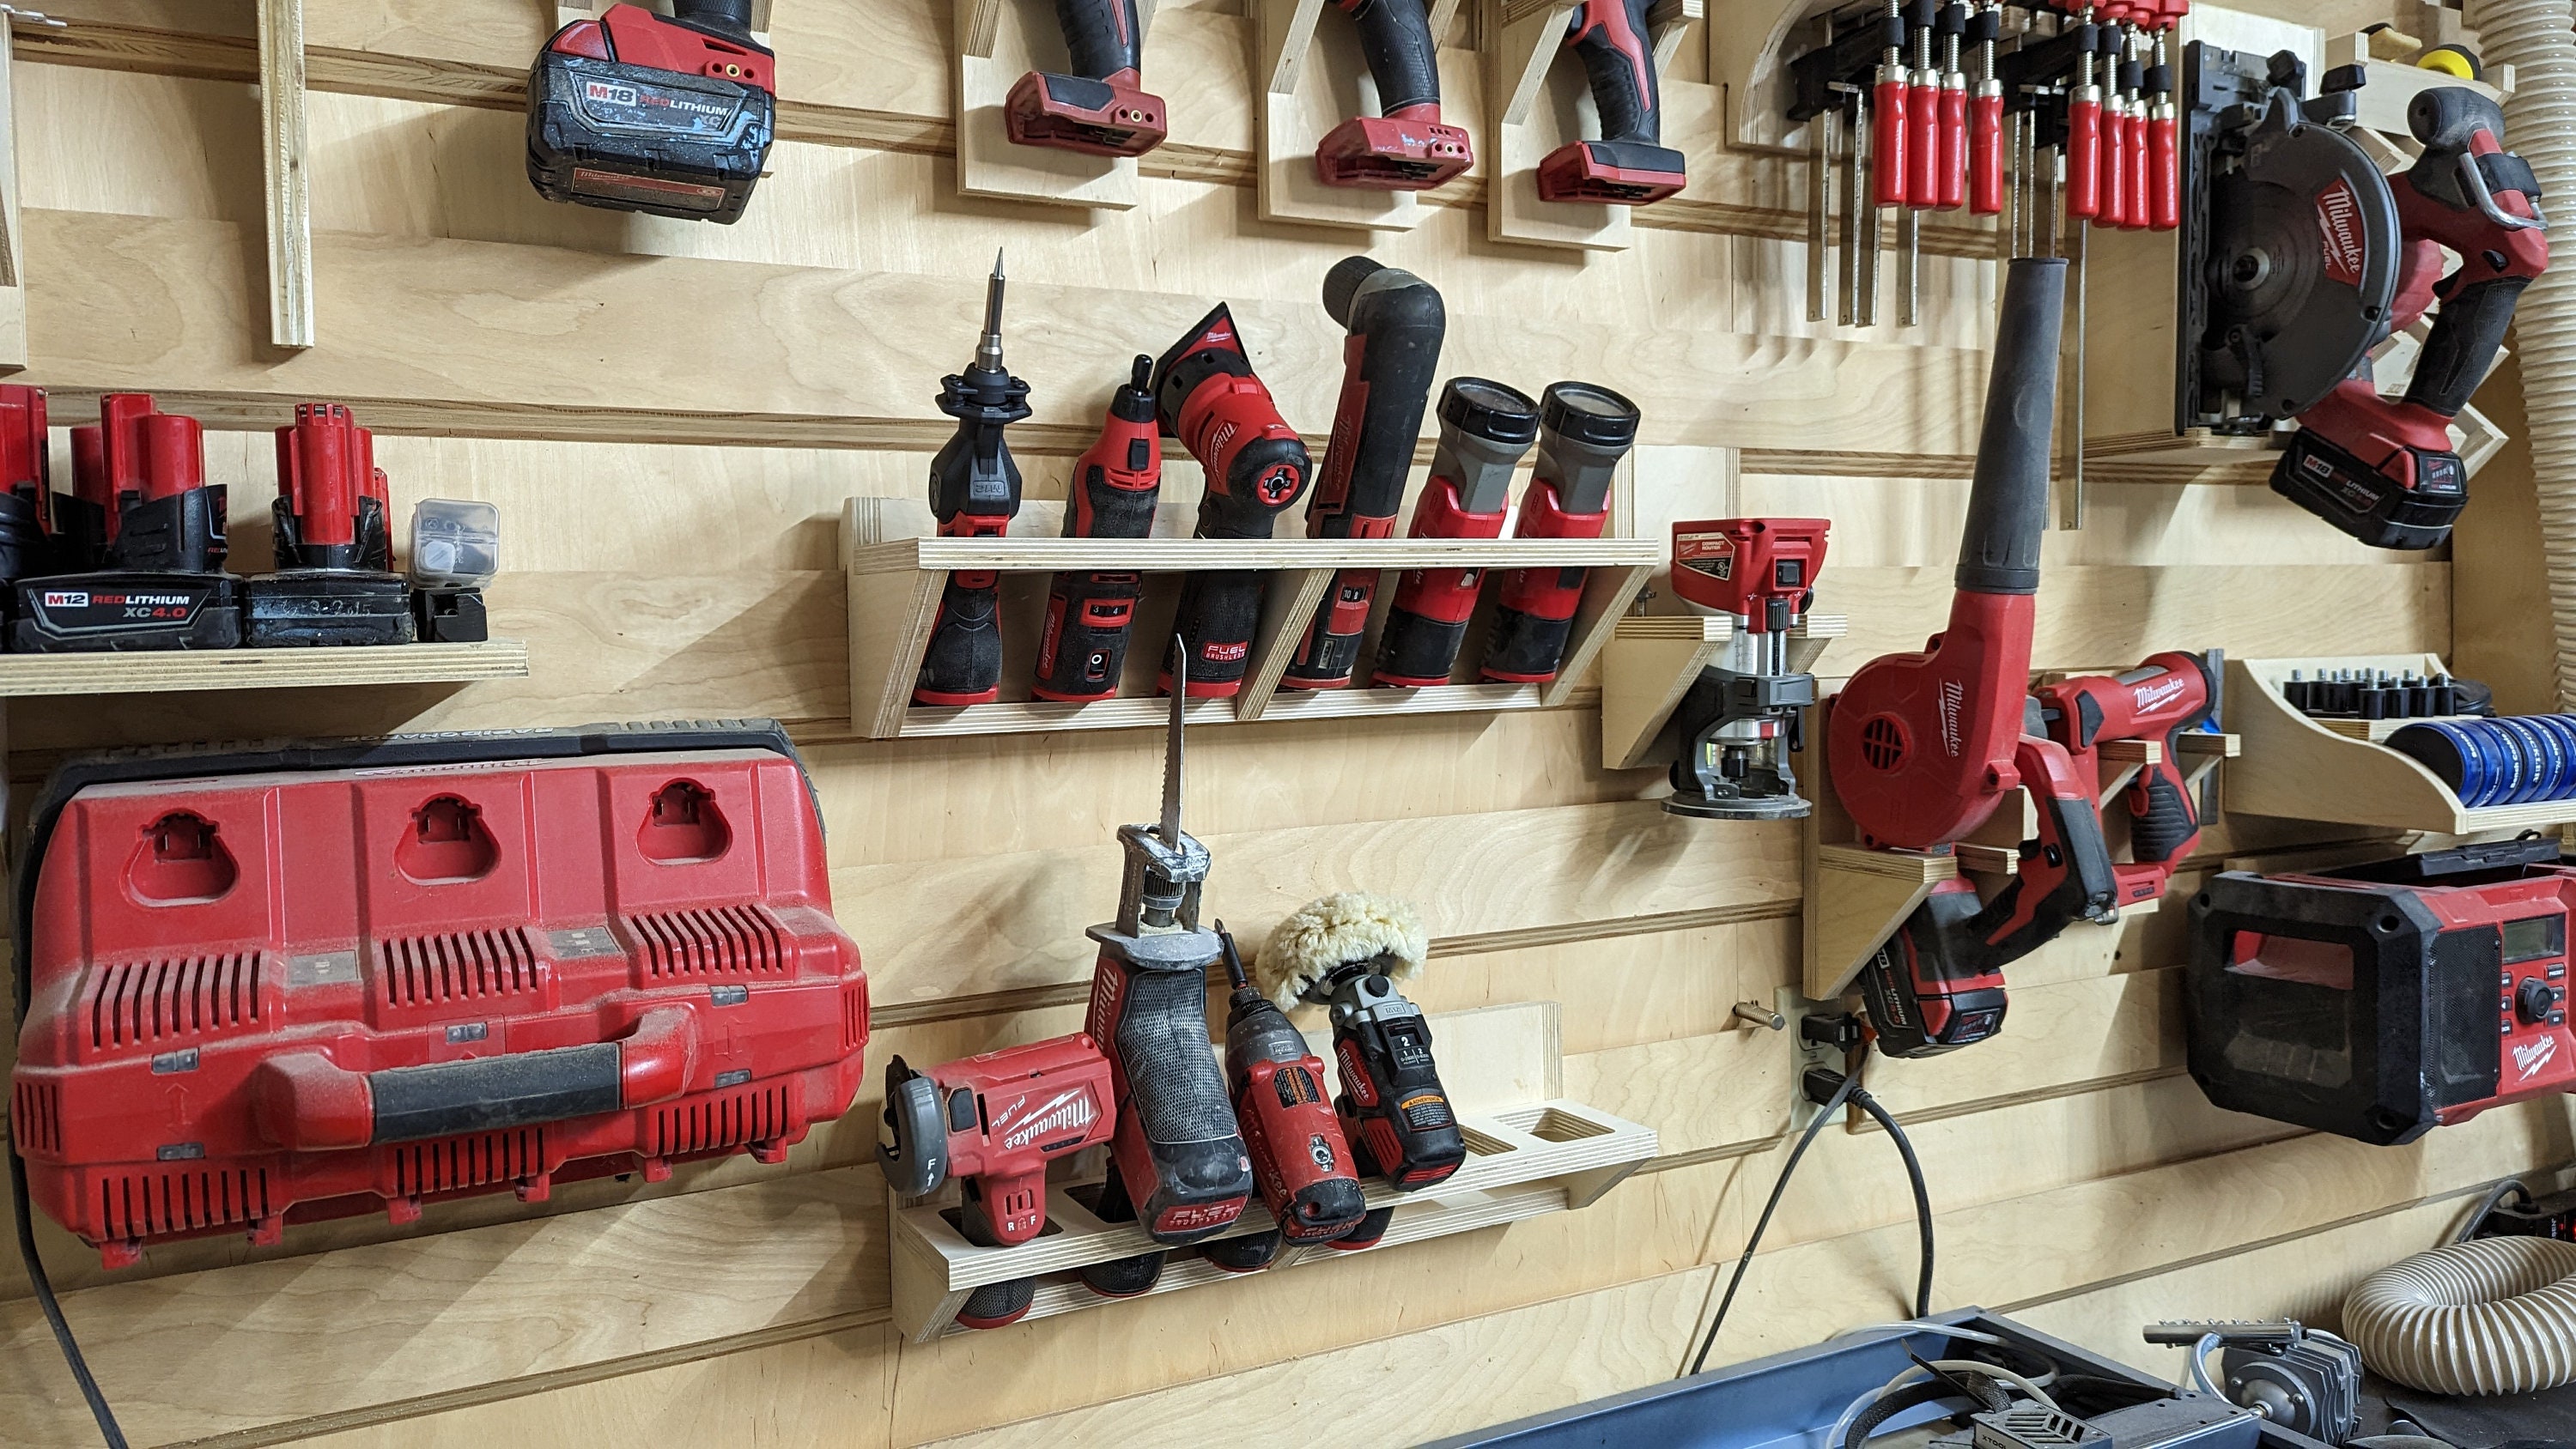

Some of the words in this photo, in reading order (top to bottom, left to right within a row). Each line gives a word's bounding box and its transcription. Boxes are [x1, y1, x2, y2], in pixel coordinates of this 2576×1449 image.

[589, 84, 634, 103] M18
[640, 94, 728, 116] REDLITHIUM
[2322, 185, 2362, 273] Milwaukee
[2323, 240, 2332, 270] FUEL
[2305, 457, 2330, 475] M18
[47, 594, 87, 604] M12
[92, 594, 191, 605] REDLITHIUM
[1206, 652, 1245, 660] BRUSHLESS
[1207, 645, 1246, 655] FUEL
[2133, 677, 2185, 709] Milwaukee
[1944, 678, 1965, 758] Milwaukee
[2500, 733, 2518, 761] Cookie
[2509, 721, 2542, 783] ROCKLER
[2510, 761, 2520, 789] Bench
[1885, 969, 1908, 1026] REDLITHIUM
[1400, 1036, 1411, 1047] 2
[2512, 1034, 2555, 1071] Milwaukee
[1339, 1047, 1370, 1100] Milwaukee
[991, 1094, 1026, 1127] FUEL
[1004, 1095, 1094, 1149] Milwaukee
[927, 1157, 937, 1170] F
[1007, 1222, 1015, 1232] R
[1030, 1215, 1036, 1225] F
